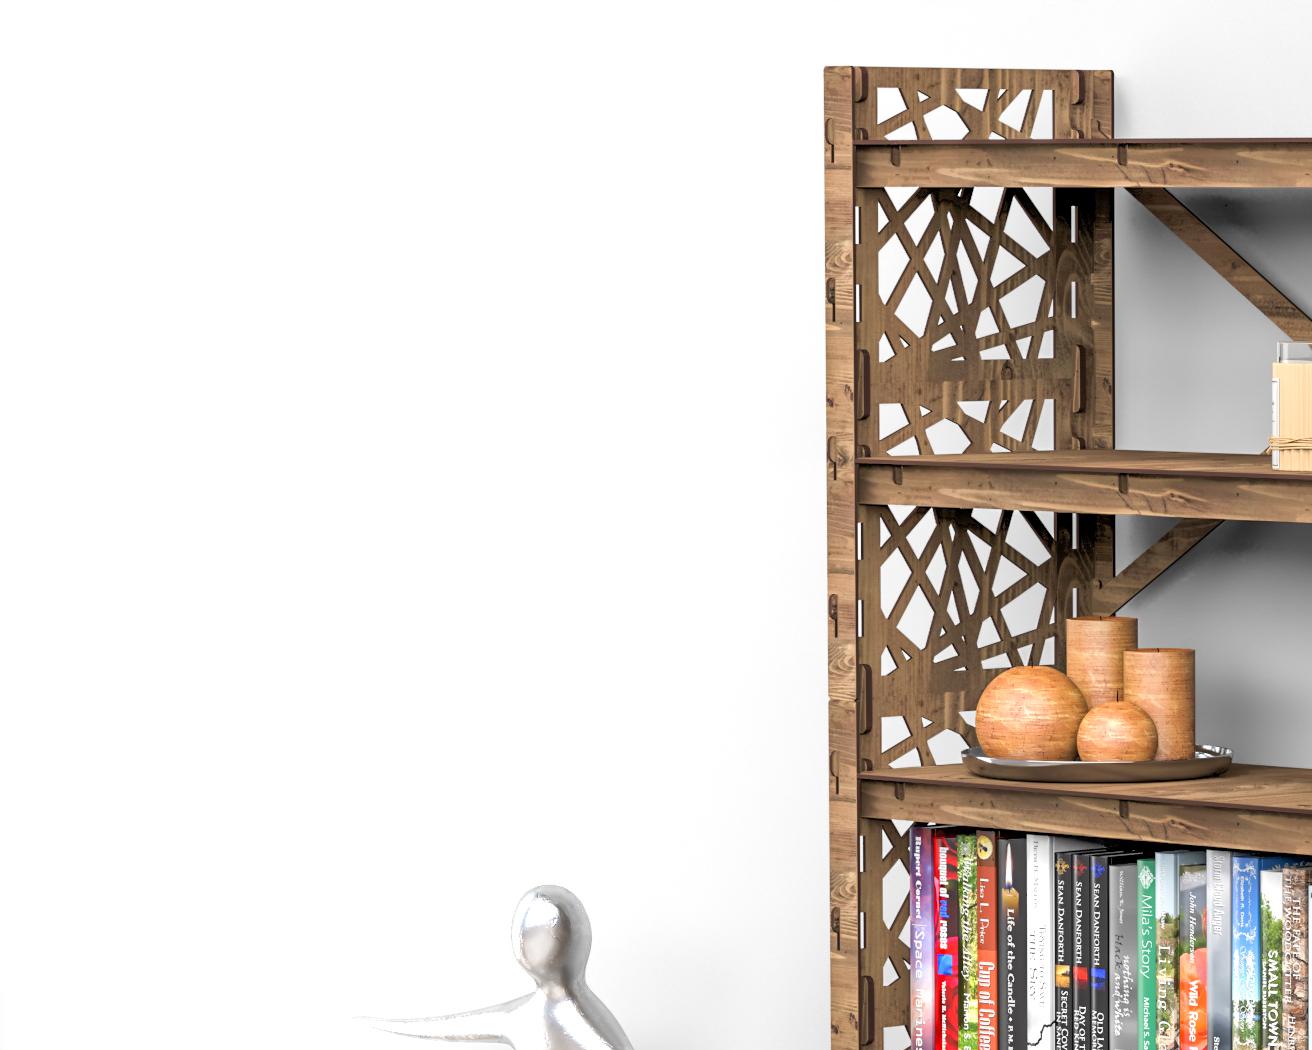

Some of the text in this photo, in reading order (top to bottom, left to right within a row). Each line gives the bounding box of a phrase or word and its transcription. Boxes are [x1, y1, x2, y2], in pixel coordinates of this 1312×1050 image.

[913, 836, 922, 877] Rupert
[1213, 856, 1224, 880] Storm
[938, 846, 949, 949] bouquet of red roses
[961, 859, 973, 916] Walking
[979, 878, 989, 944] Lisa L. Price
[1006, 908, 1015, 932] Life
[1211, 909, 1224, 937] Anger
[962, 920, 971, 942] the
[1006, 934, 1015, 946] of
[1140, 894, 1152, 979] Mila's Story
[1292, 897, 1300, 981] THE FATE OF
[914, 930, 924, 979] Space
[961, 945, 971, 981] Alley
[1006, 950, 1015, 970] the
[1284, 906, 1292, 1004] WOODCUTTER
[978, 961, 995, 987] Cup
[1112, 934, 1125, 1037] black and white
[1121, 954, 1133, 1017] nothing is
[1157, 945, 1171, 1011] Living
[978, 991, 994, 1006] of
[1007, 972, 1015, 1014] Candle
[1060, 990, 1068, 1026] SECRET
[1188, 979, 1199, 1006] Wild
[1267, 950, 1278, 1047] SMALL TOWN
[1056, 1011, 1061, 1021] IN
[1096, 1012, 1104, 1035] OLD
[1188, 1011, 1198, 1042] Rose
[1287, 1015, 1296, 1050] HENRY
[1007, 1033, 1013, 1044] M.
[1079, 1028, 1085, 1041] OF
[1143, 1031, 1149, 1039] S.
